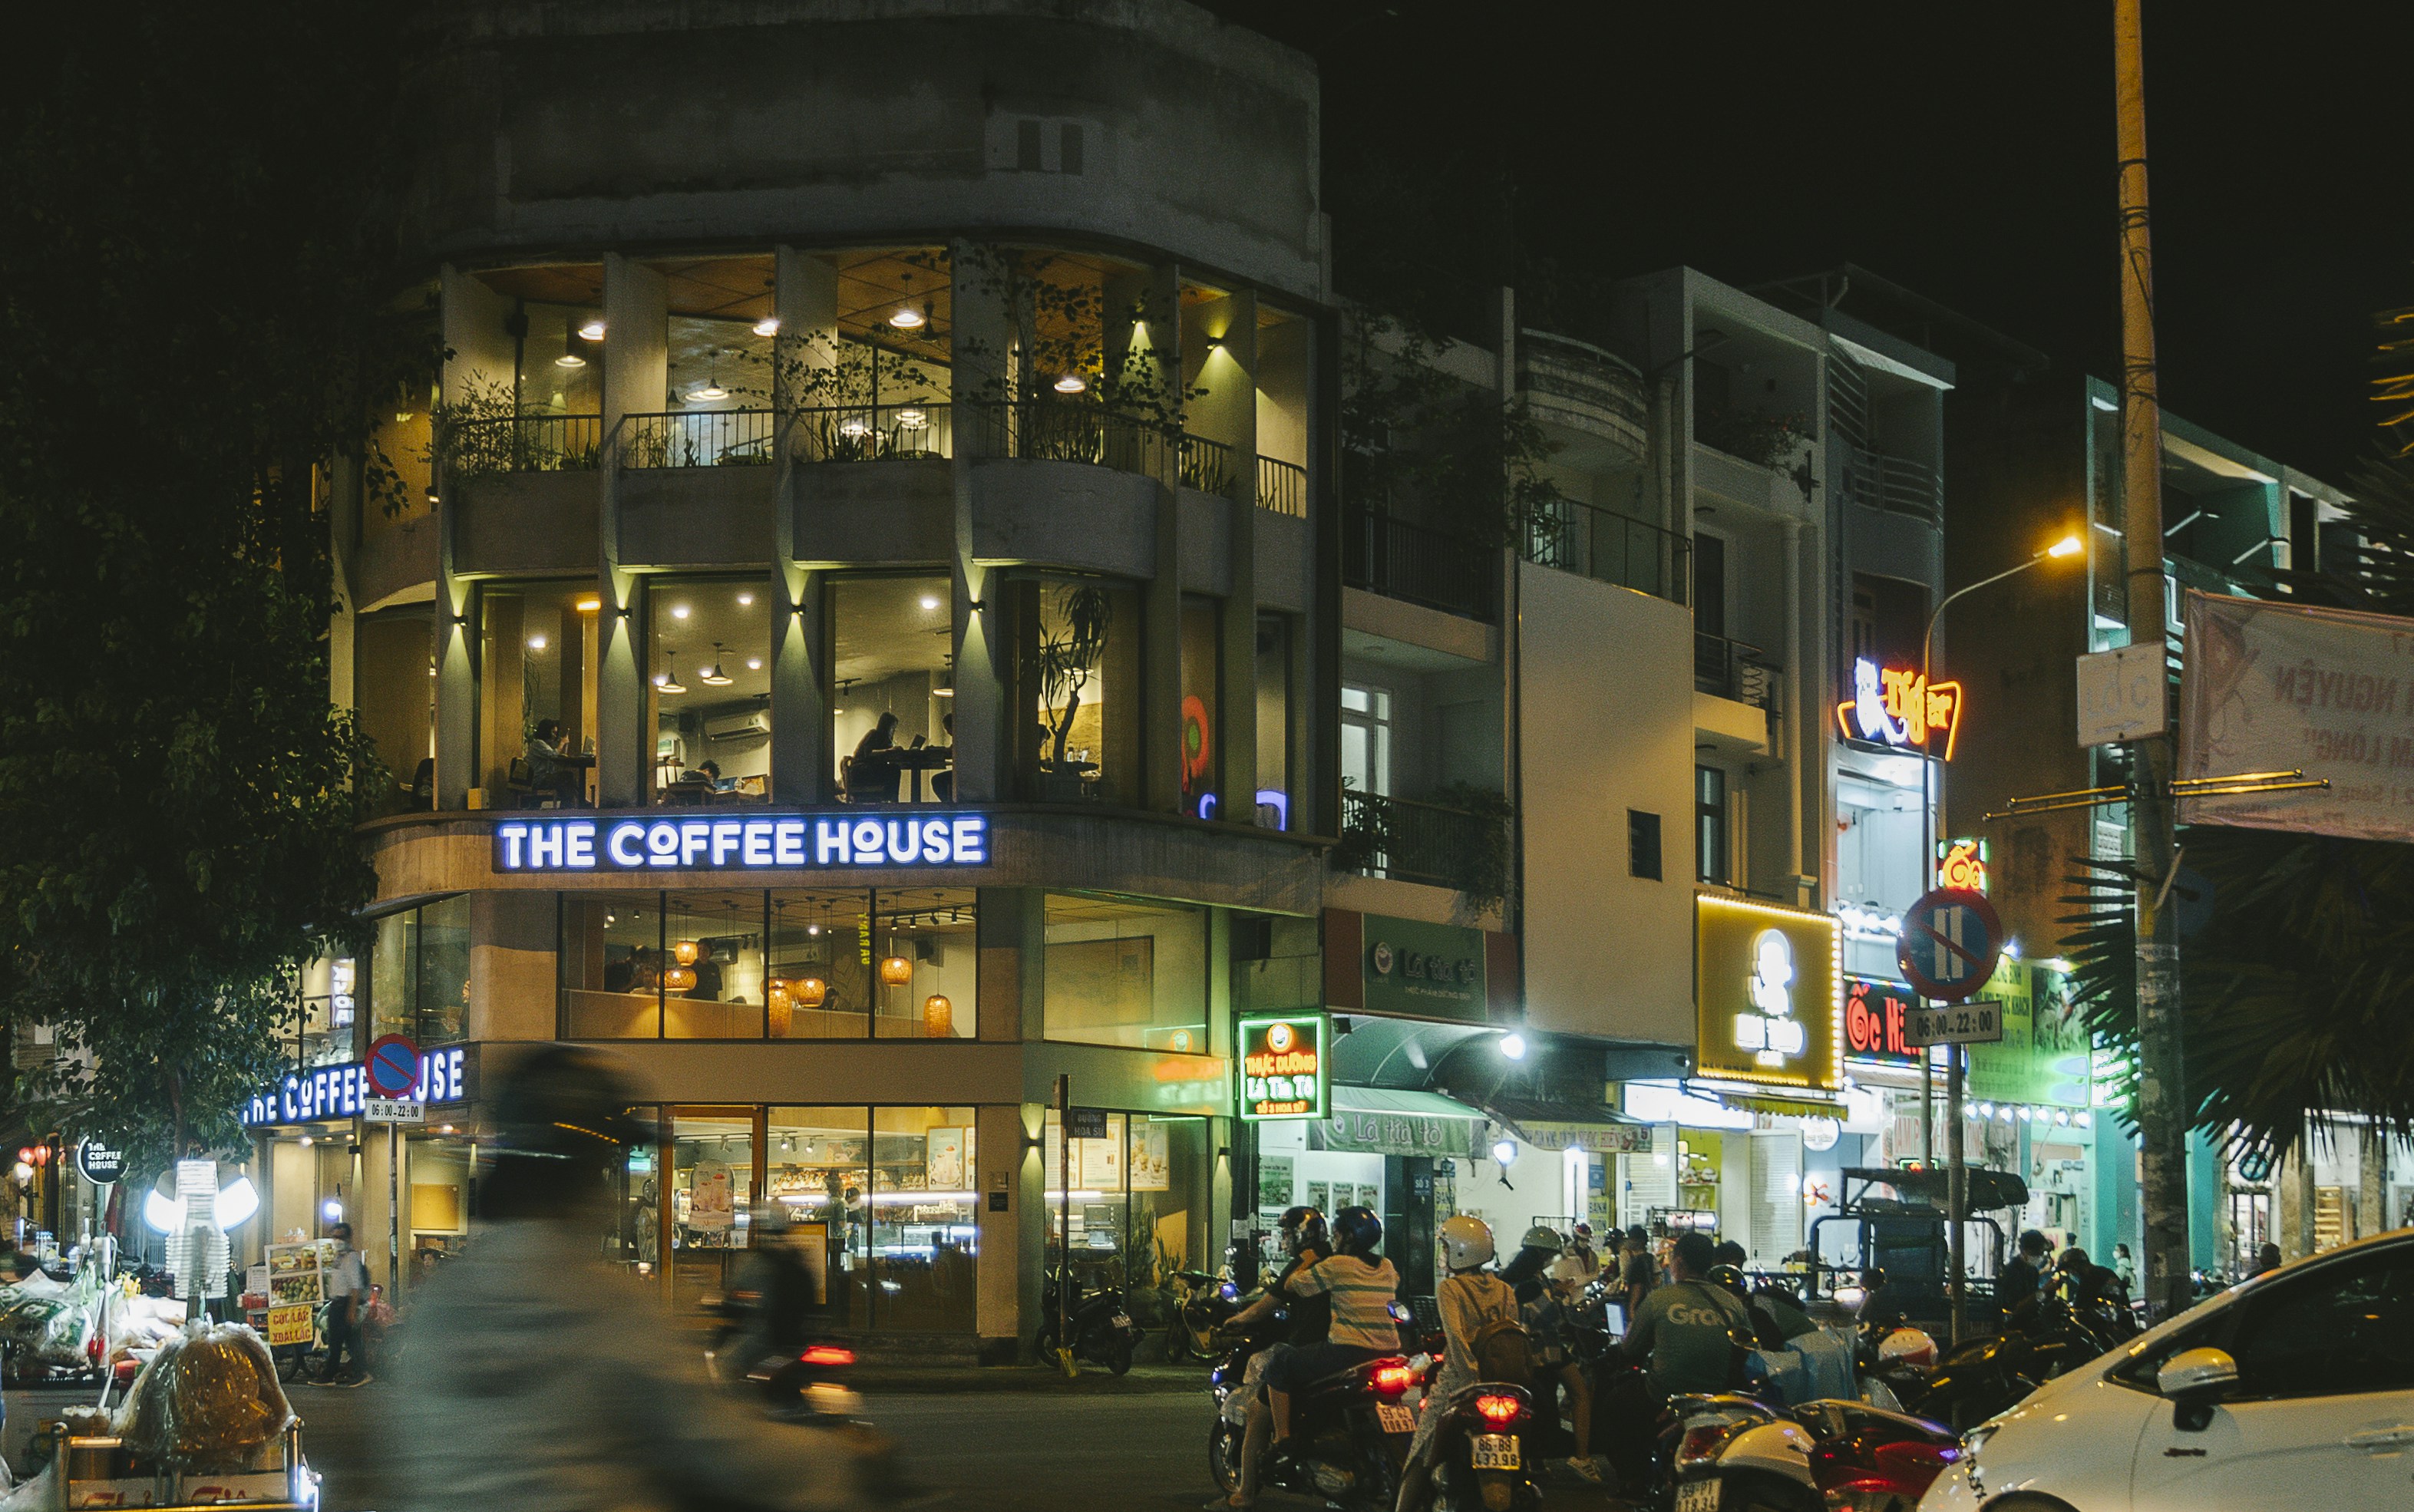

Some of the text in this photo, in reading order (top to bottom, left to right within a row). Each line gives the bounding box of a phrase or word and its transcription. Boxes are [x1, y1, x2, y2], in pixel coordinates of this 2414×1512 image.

[501, 820, 983, 867] THE COFFEE HOUSE
[88, 1151, 121, 1160] COFFEE
[88, 1160, 117, 1169] HOUSE
